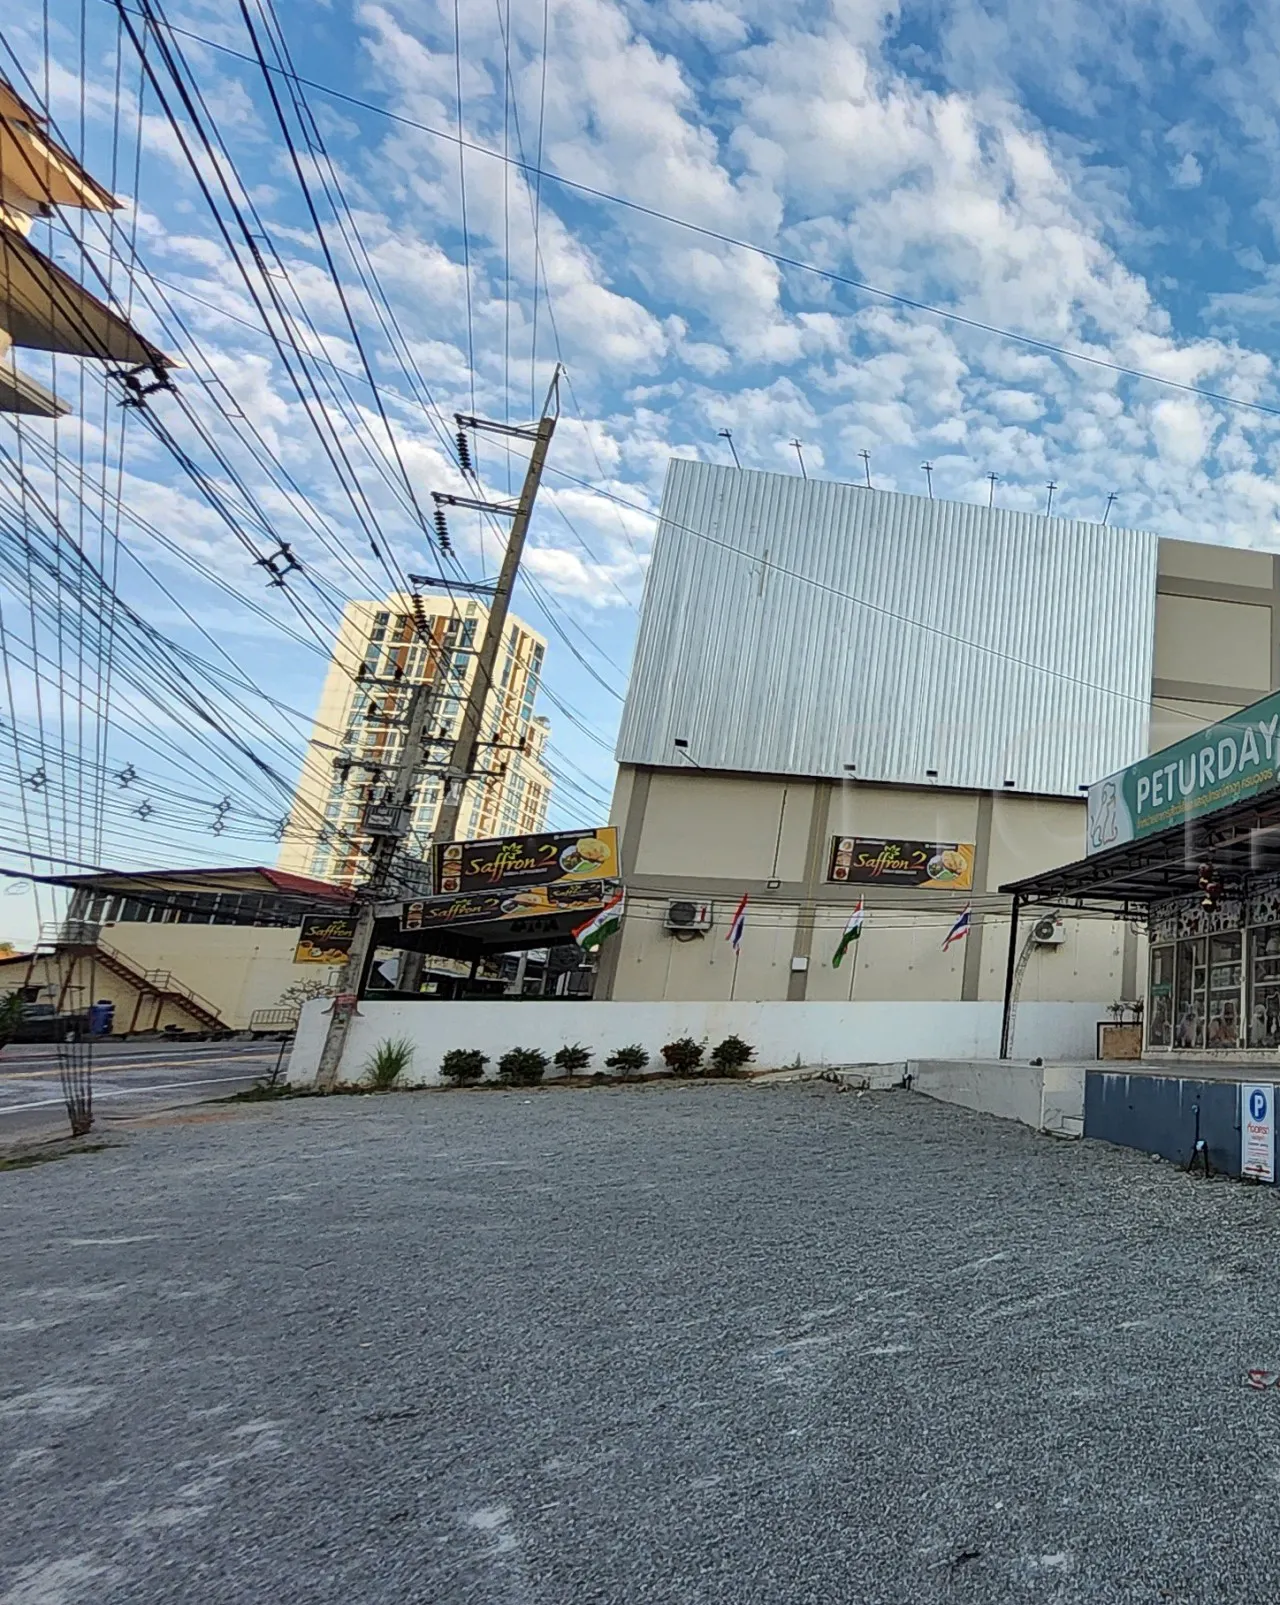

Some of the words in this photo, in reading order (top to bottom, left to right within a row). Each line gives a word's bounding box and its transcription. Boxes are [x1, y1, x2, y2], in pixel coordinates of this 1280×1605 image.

[1136, 714, 1279, 815] PETURDAY
[465, 850, 537, 883] Saffron
[537, 844, 559, 867] 2
[853, 851, 909, 877] Saffron
[909, 850, 928, 870] 2
[425, 901, 481, 921] Saffron
[305, 924, 352, 941] Saffron
[1254, 1094, 1264, 1117] P
